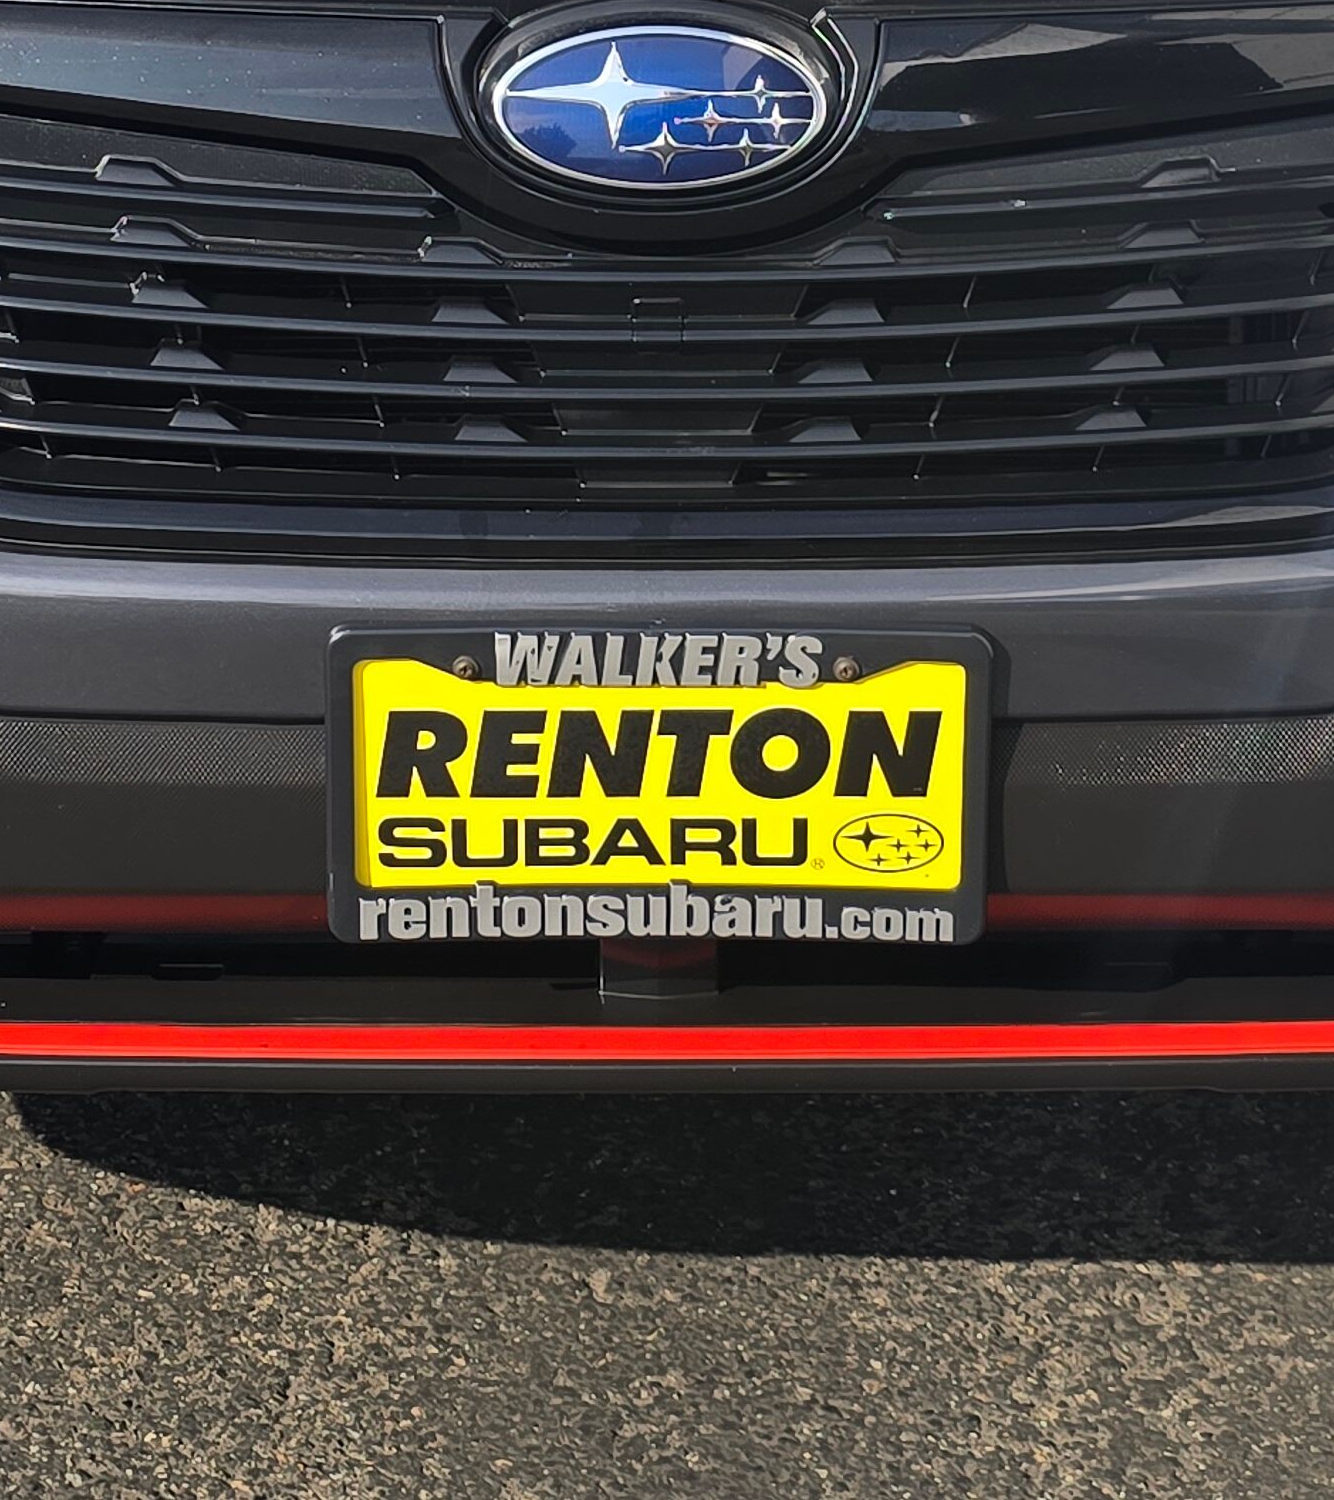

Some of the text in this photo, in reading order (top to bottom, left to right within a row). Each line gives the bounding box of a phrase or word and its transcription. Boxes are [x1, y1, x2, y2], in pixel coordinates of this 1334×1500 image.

[494, 631, 823, 687] WALKER'S
[376, 708, 943, 798] RENTON
[377, 817, 809, 867] SUBARU
[359, 881, 955, 942] rentonsubaru.com
